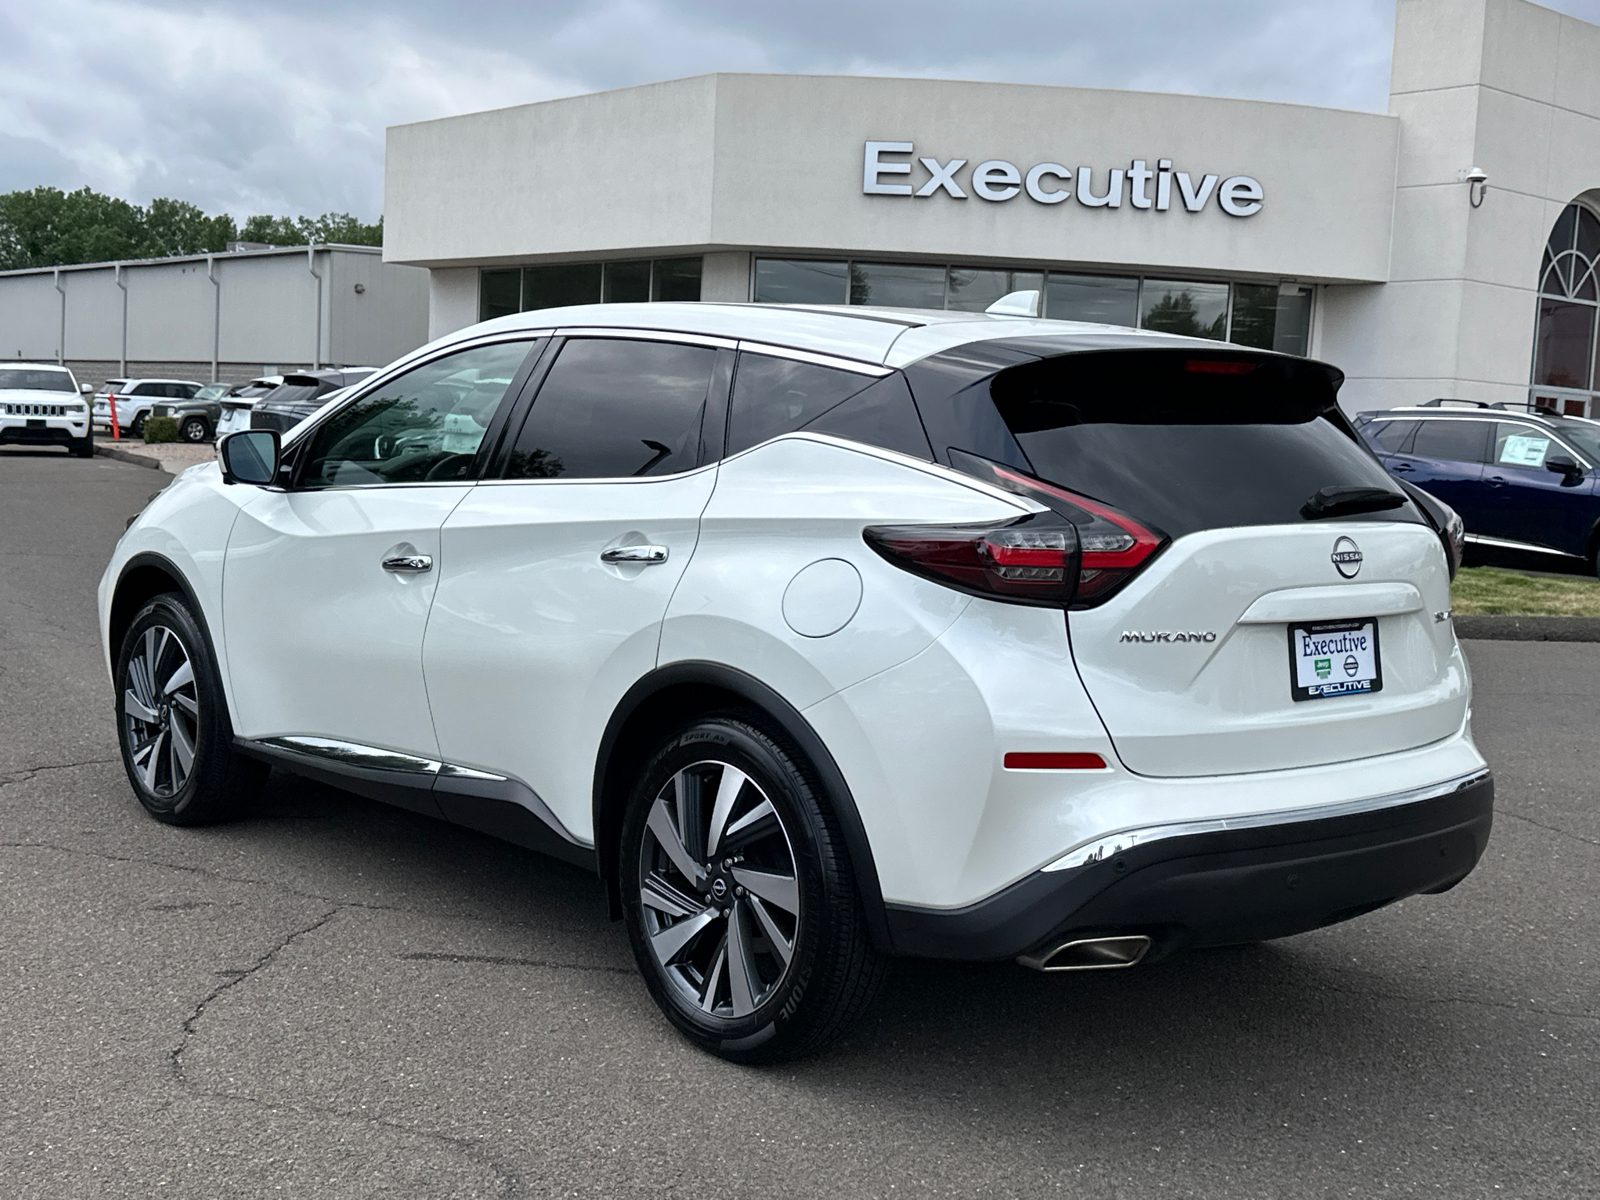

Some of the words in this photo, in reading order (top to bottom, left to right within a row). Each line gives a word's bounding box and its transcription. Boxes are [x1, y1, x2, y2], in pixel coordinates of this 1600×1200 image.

[863, 139, 1265, 217] Executive
[1332, 552, 1362, 562] NISSAN
[1119, 630, 1217, 643] MURANO
[1302, 632, 1367, 657] Executive
[1316, 660, 1330, 669] Jeep
[1308, 680, 1372, 696] EXECUTIVE
[684, 732, 710, 742] SPORT
